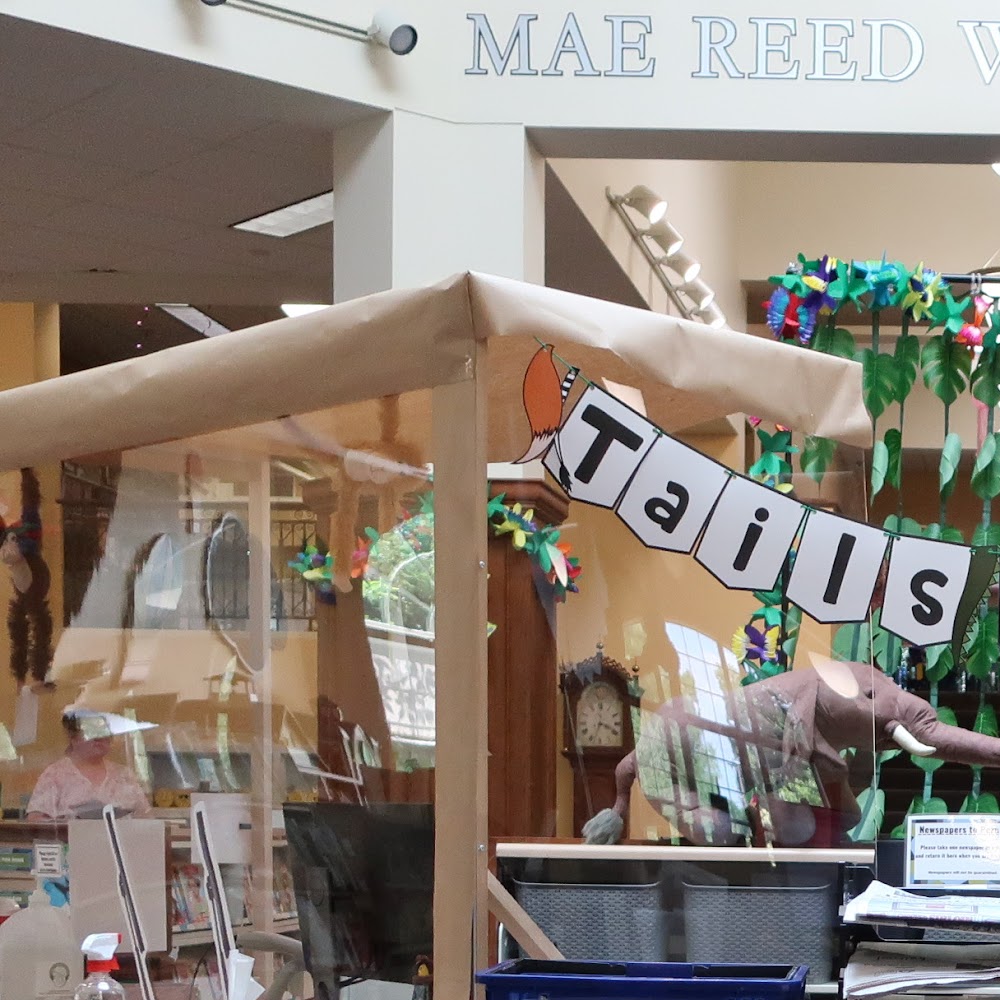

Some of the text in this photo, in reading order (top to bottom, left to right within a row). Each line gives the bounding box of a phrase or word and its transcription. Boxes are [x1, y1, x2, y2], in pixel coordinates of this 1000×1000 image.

[464, 12, 656, 78] MAE
[691, 15, 925, 82] REED
[574, 404, 949, 626] Tails
[920, 826, 966, 835] Newspapers
